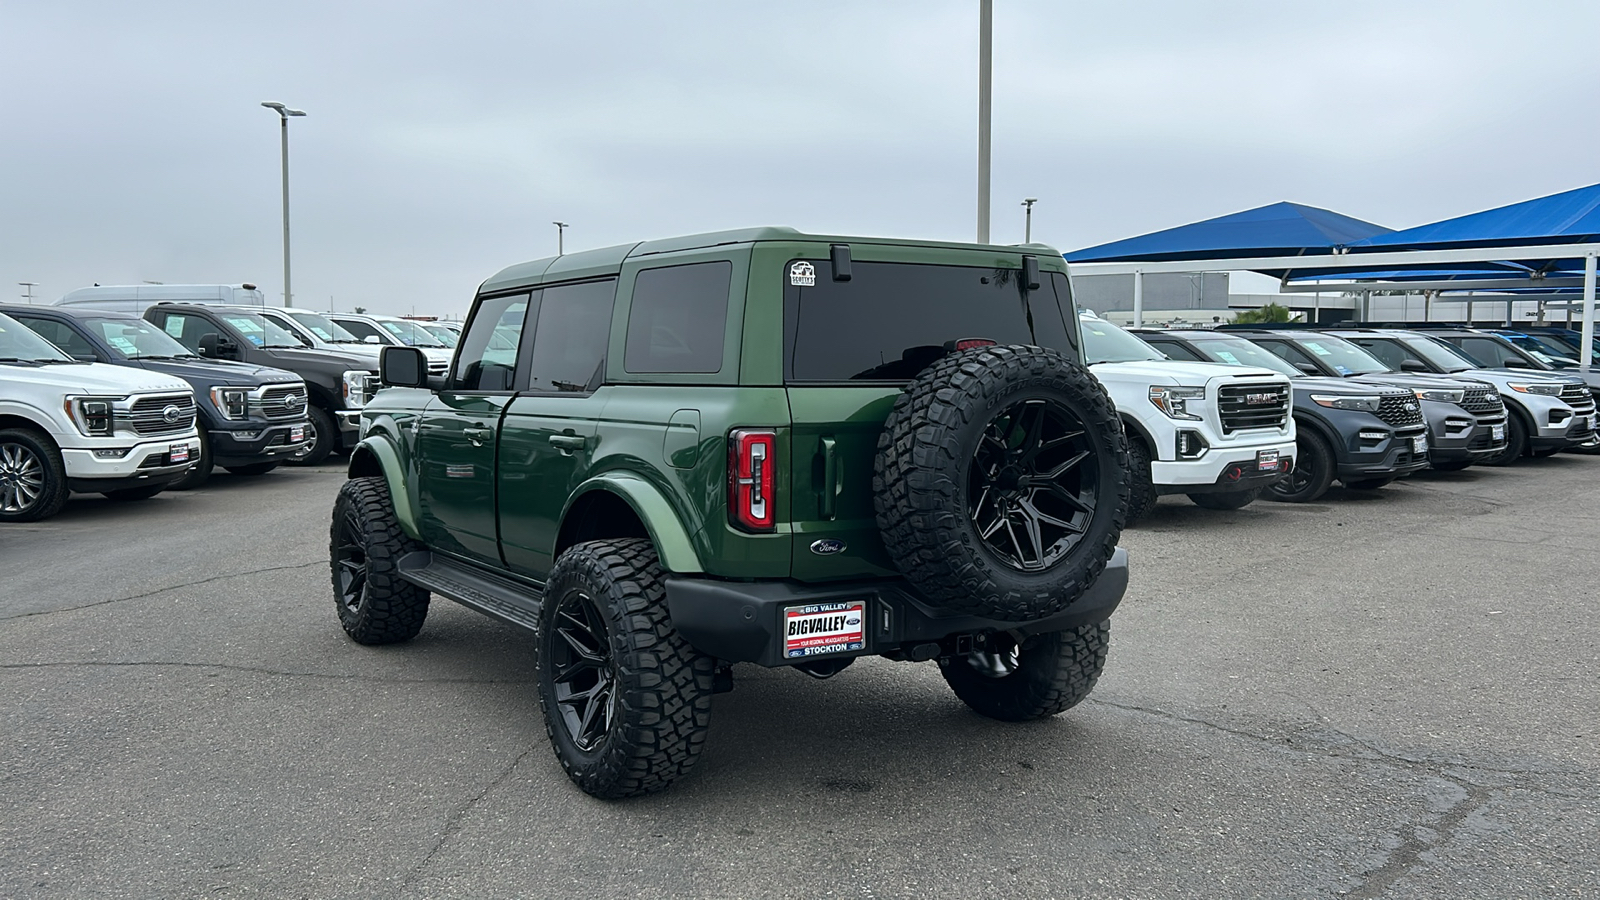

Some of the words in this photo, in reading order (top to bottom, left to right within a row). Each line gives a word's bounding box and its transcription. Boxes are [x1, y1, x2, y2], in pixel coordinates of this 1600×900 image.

[1246, 393, 1278, 405] GMC
[820, 603, 847, 611] VALLEY
[788, 615, 847, 636] BIGVALLEY
[804, 643, 847, 656] STOCKTON
